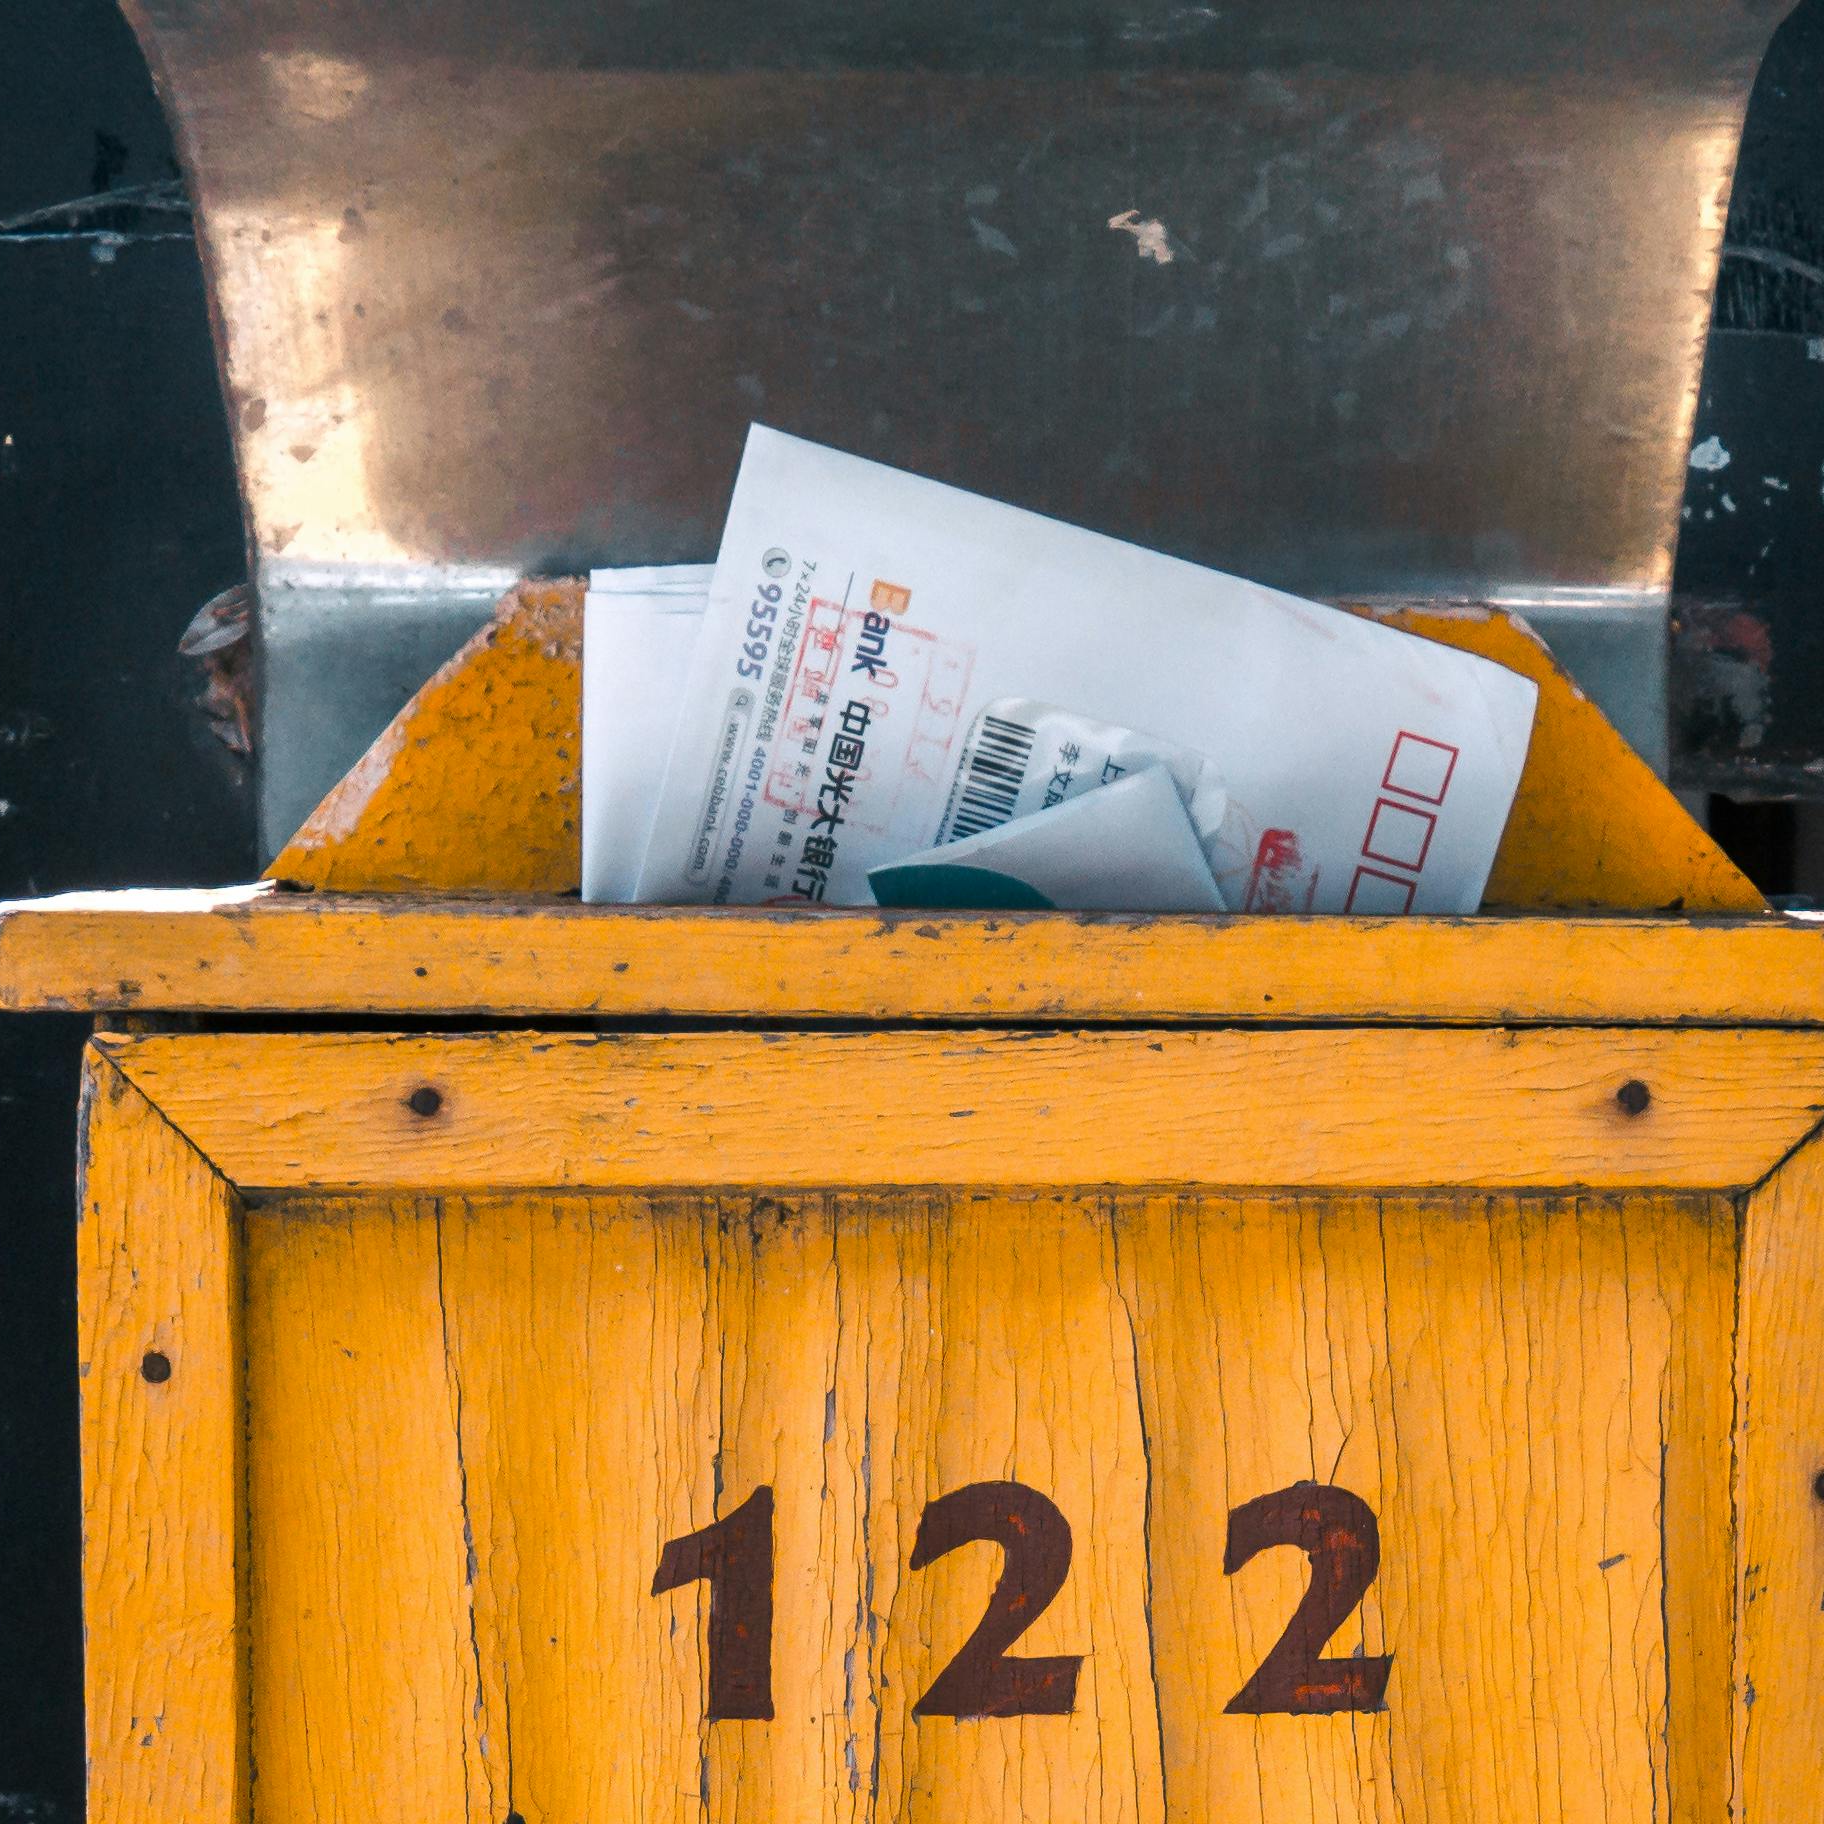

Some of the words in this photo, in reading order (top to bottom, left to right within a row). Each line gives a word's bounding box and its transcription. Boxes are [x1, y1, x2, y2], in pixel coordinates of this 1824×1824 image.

[737, 584, 783, 680] 95595
[851, 578, 911, 676] Bank
[791, 700, 870, 901] 中国光大银行
[651, 1480, 1392, 1720] 122
